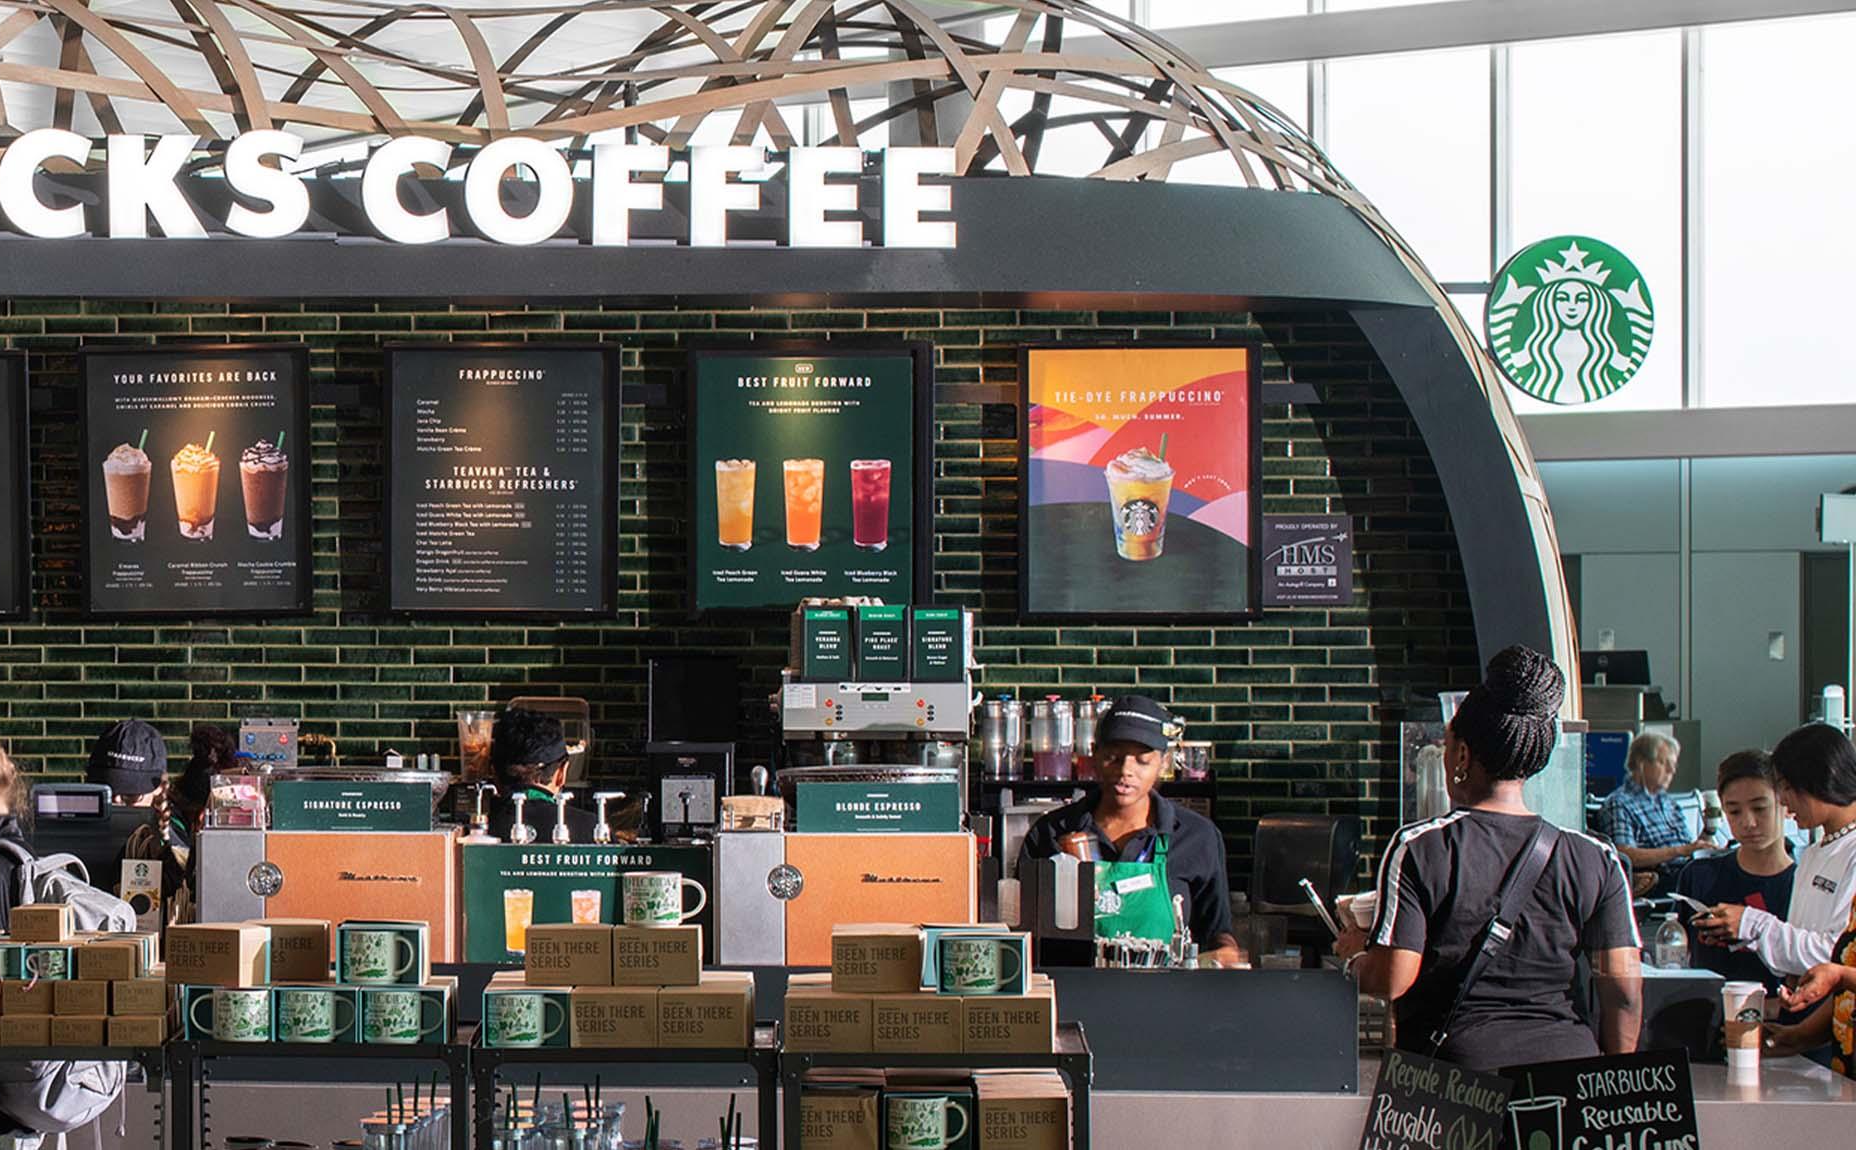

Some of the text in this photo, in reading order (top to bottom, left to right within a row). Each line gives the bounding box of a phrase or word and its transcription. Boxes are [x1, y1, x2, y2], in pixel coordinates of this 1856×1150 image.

[362, 136, 957, 248] COFFEE
[113, 371, 276, 384] YOUR FAVORITES ARE BACK
[738, 376, 872, 388] BEST FRUIT FORWARD
[1055, 391, 1112, 403] TIE-DYE
[516, 466, 537, 476] TEA
[544, 466, 550, 476] &
[424, 479, 492, 490] STARBUCKS
[1281, 544, 1336, 565] HMS
[304, 800, 402, 810] SIGNATURE ESPRESSO
[836, 802, 922, 812] BLONDE ESPRESSO
[522, 854, 653, 866] BEST FRUIT FORWARD
[169, 940, 231, 954] BEEN THERE
[530, 942, 601, 954] BEEN THERE
[618, 941, 689, 955] BEEN THERE
[836, 947, 908, 961] BEEN THERE
[170, 954, 206, 968] SERIES
[530, 956, 572, 969] SERIES
[618, 955, 660, 969] SERIES
[836, 962, 878, 976] SERIES
[575, 1005, 646, 1018] BEEN THERE
[662, 1006, 733, 1020] BEEN THERE
[790, 1010, 860, 1024] BEEN THERE
[878, 1011, 950, 1025] BEEN THERE
[968, 1010, 1040, 1024] BEEN THERE
[575, 1020, 617, 1034] SERIES
[662, 1020, 704, 1034] SERIES
[790, 1025, 832, 1038] SERIES
[878, 1026, 920, 1040] SERIES
[968, 1026, 1010, 1039] SERIES
[1576, 1064, 1676, 1100] STARBUCKS
[826, 1110, 864, 1124] THERE
[985, 1111, 1057, 1124] BEEN THERE
[1373, 1093, 1442, 1150] Reusable
[1580, 1101, 1682, 1130] Reusable
[985, 1126, 1028, 1139] SERIES
